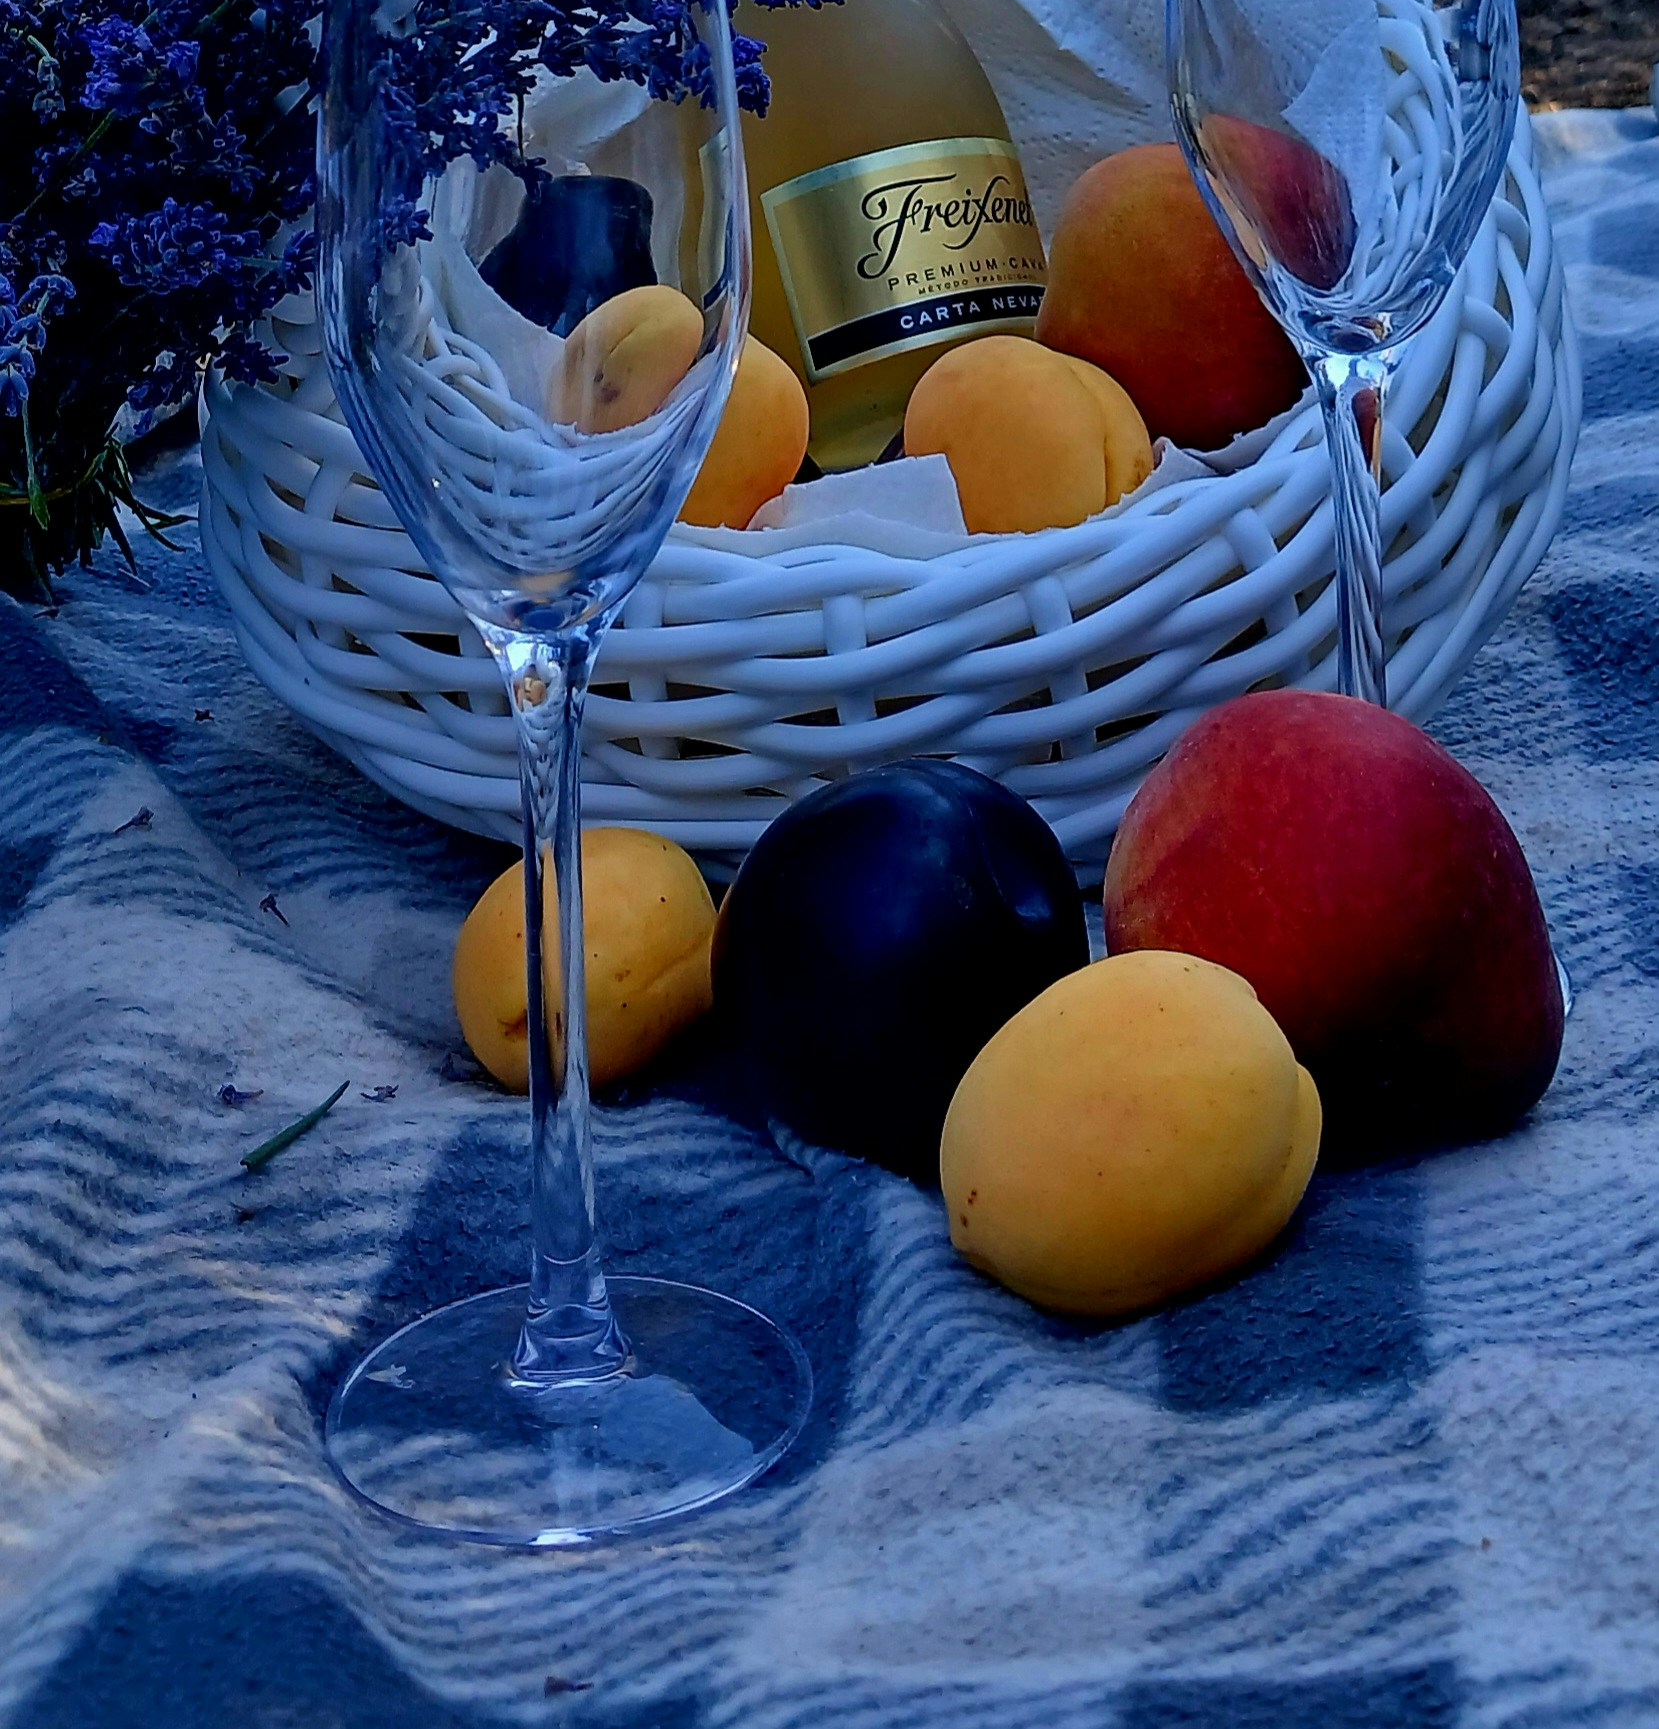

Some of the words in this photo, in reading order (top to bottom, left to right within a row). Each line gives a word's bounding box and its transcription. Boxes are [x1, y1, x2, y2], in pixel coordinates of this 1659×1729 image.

[888, 257, 998, 291] PREMIUM
[900, 301, 981, 329] CARTA
[991, 295, 1044, 310] NEVA
